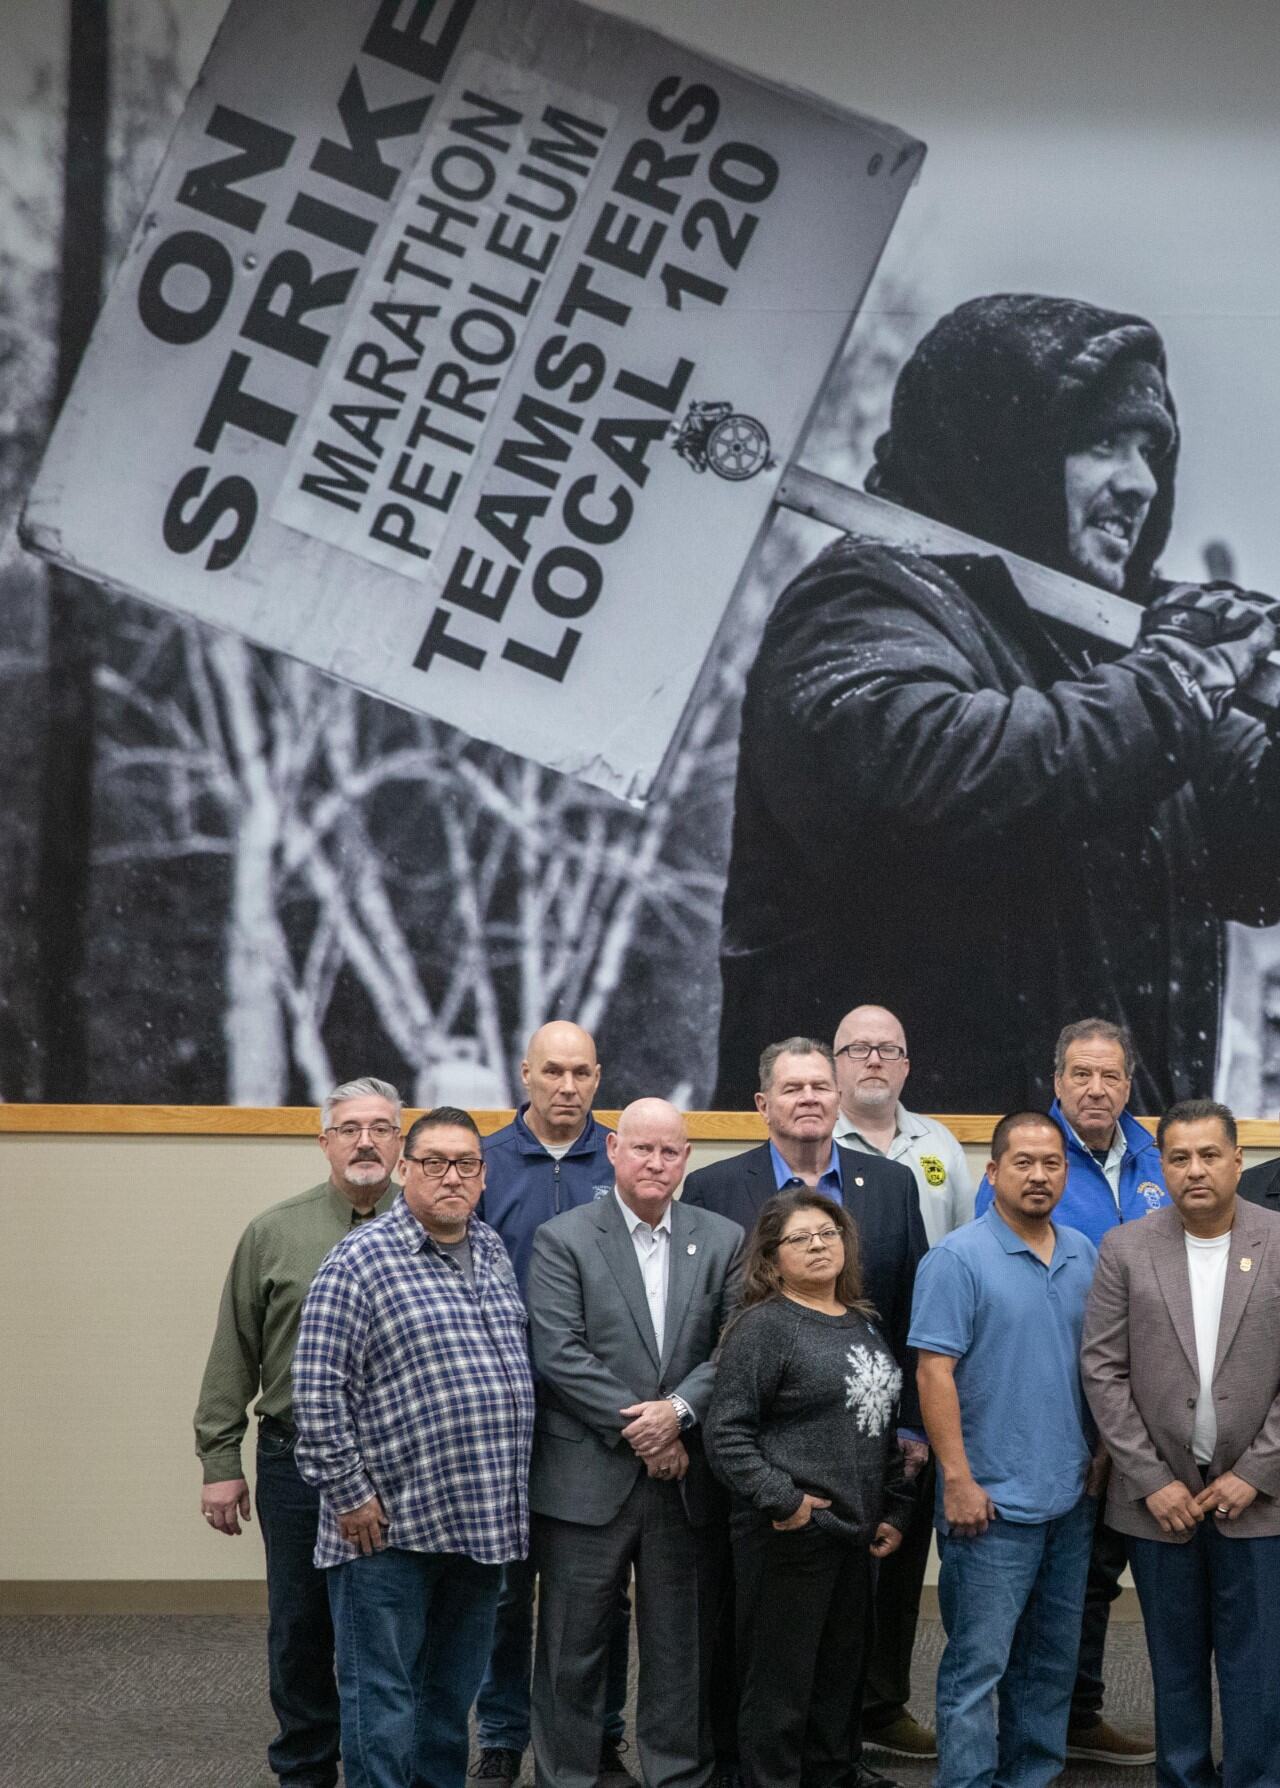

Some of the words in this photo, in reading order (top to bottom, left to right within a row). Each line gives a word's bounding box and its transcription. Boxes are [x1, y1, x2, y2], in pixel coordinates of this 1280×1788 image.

[138, 104, 295, 345] ON
[163, 0, 478, 571] STRIKE
[299, 90, 523, 513] MARATHON
[369, 105, 607, 560] PETROLEUM
[412, 75, 720, 672] TEAMSTERS
[501, 358, 696, 684] LOCAL
[659, 141, 780, 312] 120
